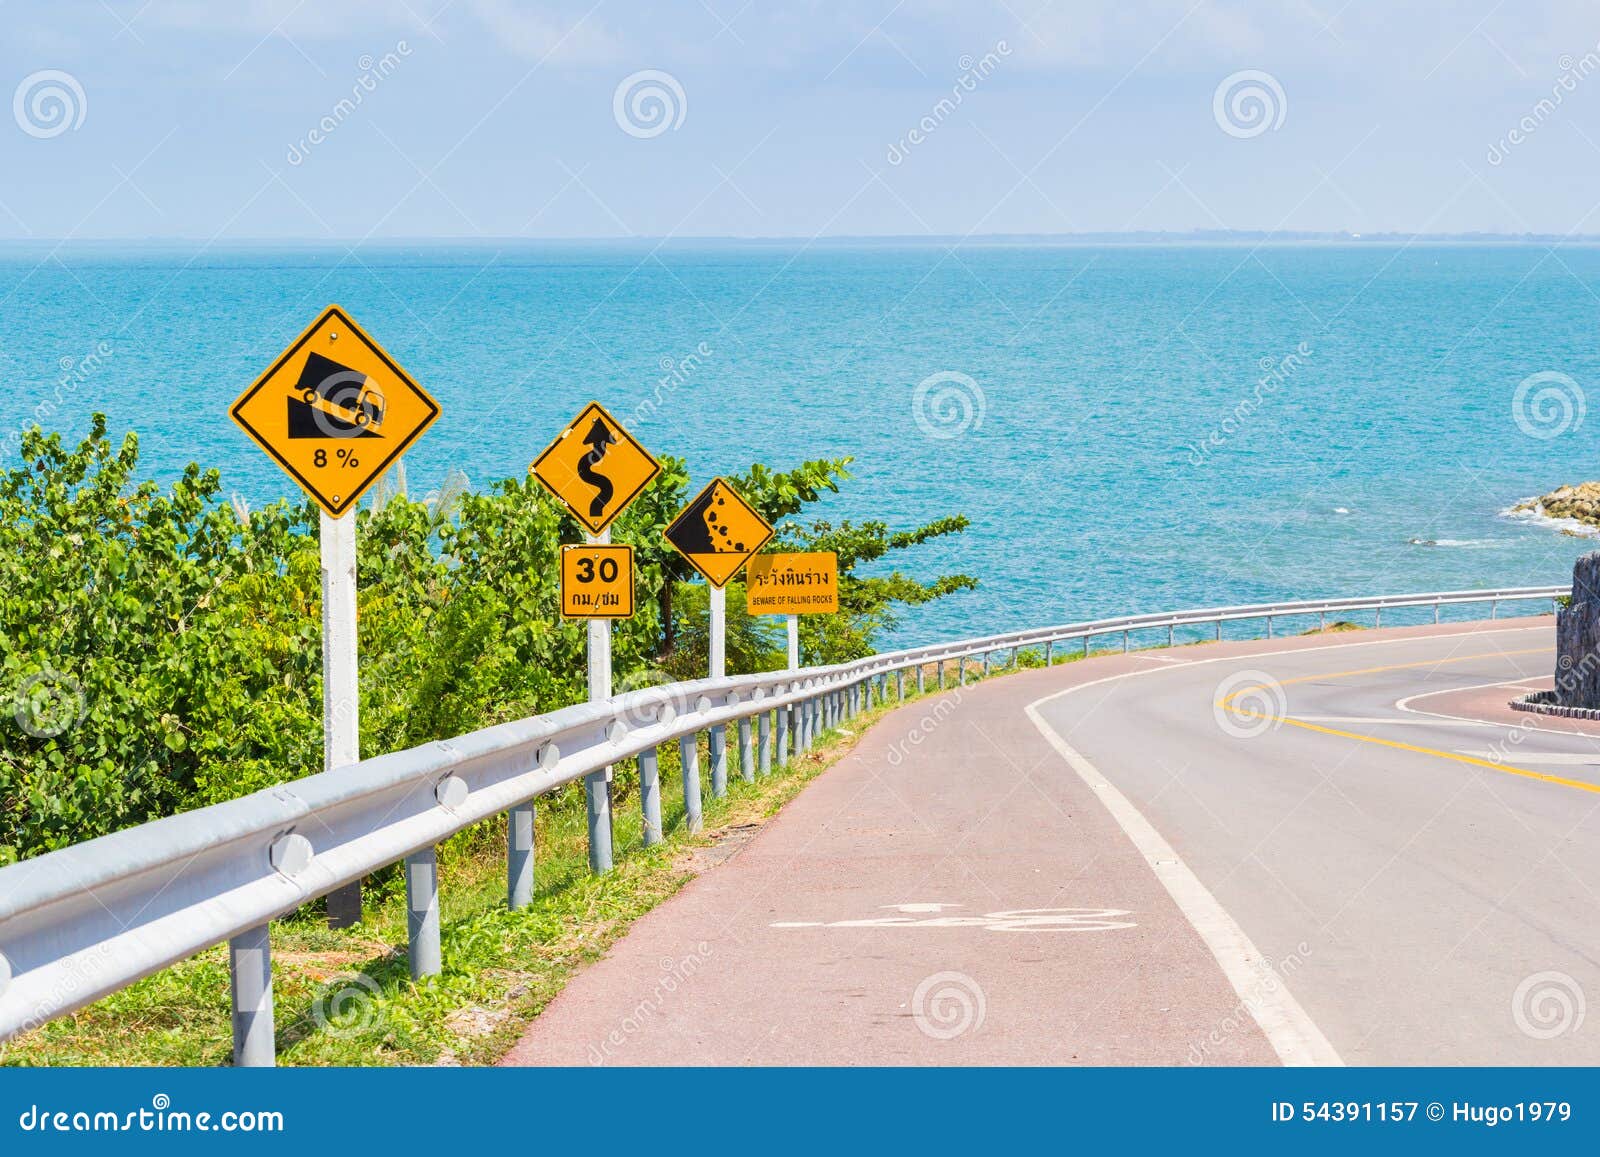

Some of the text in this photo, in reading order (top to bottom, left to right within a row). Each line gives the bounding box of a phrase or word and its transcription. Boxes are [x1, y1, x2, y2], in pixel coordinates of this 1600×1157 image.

[313, 448, 359, 468] 8 %
[575, 557, 619, 583] 30
[752, 594, 833, 606] BEWARE OF FALLING ROCKS
